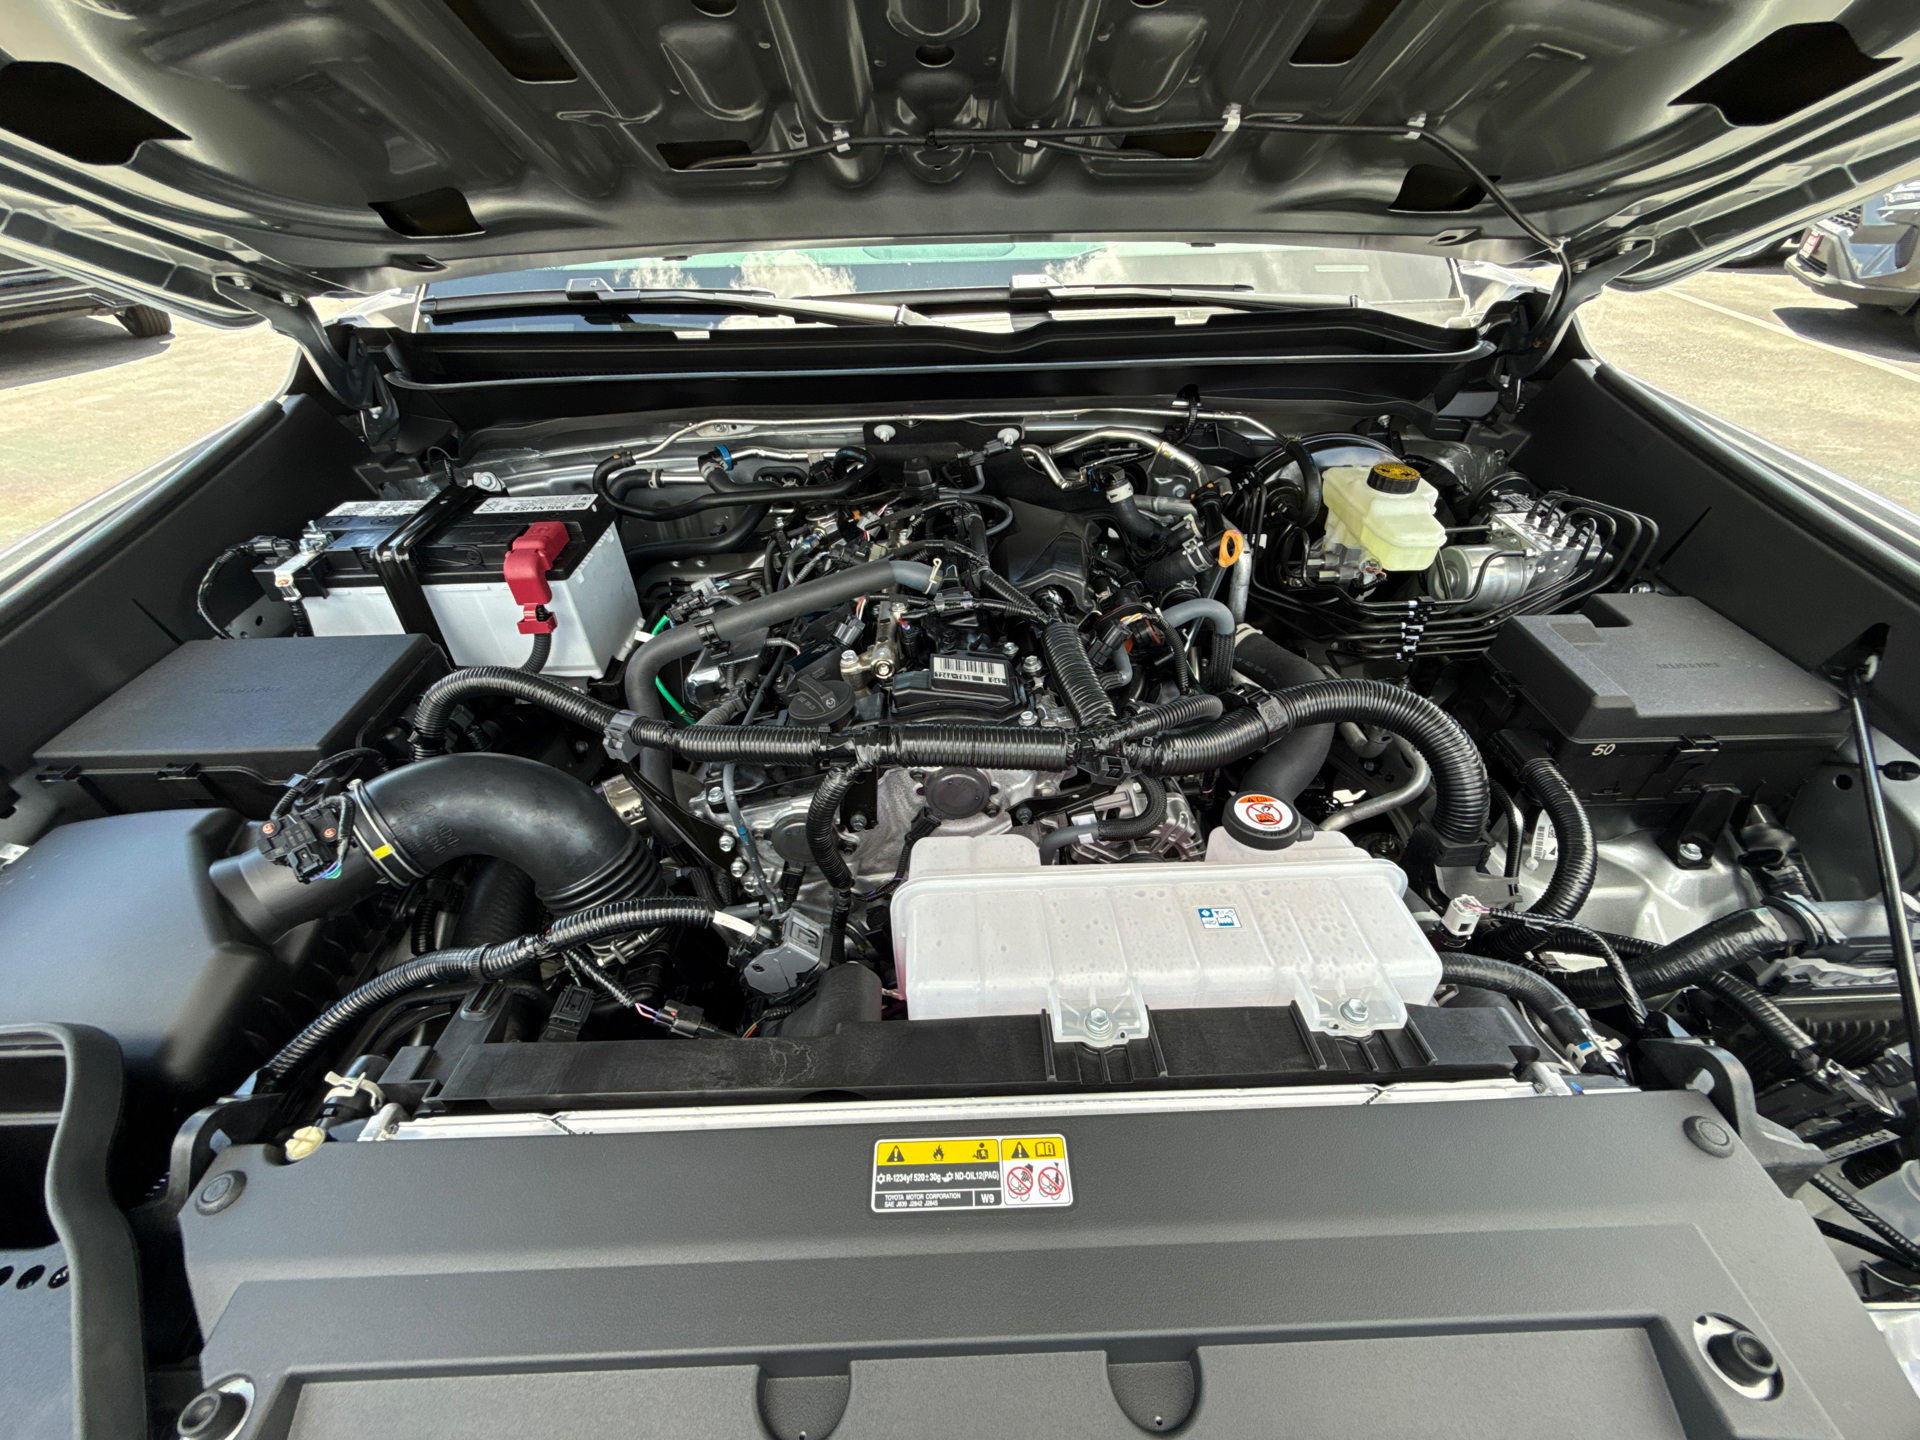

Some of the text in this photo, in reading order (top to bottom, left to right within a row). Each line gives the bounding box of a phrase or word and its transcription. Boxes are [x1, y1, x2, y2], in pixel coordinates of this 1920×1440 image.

[1591, 743, 1616, 756] 50
[885, 1171, 999, 1184] R-1234yf 520±30g ND-OIL12(PAG)
[925, 1192, 961, 1200] CORPORATION
[980, 1193, 995, 1204] W9
